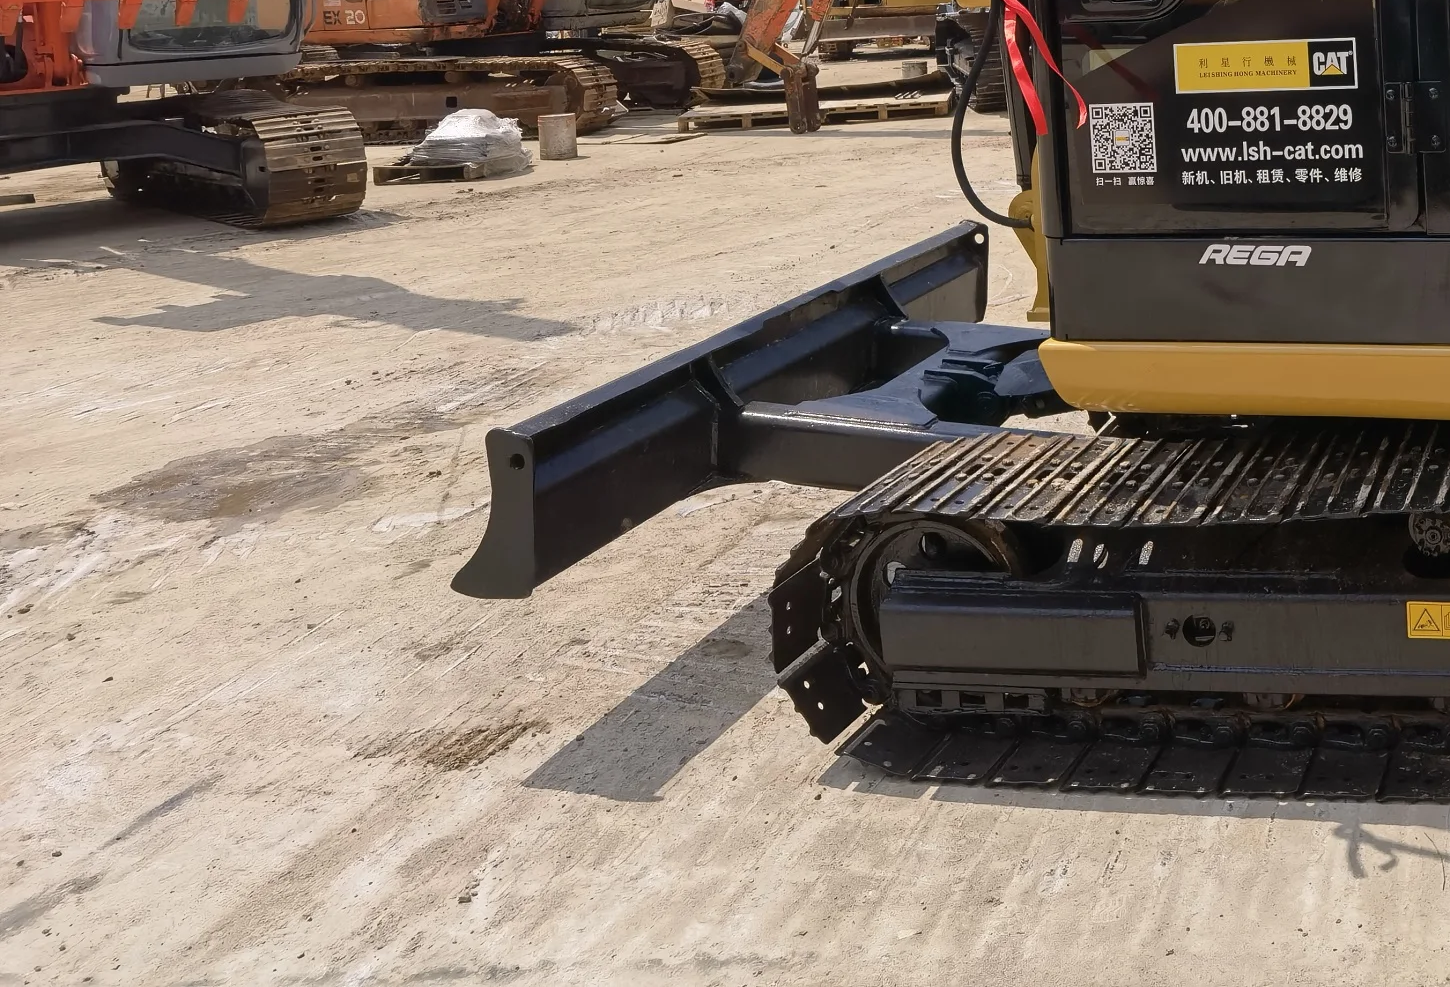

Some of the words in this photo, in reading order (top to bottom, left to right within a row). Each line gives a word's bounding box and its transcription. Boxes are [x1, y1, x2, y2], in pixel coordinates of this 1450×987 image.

[322, 10, 342, 26] EX
[1255, 69, 1297, 77] MACHINERY
[1186, 104, 1353, 134] 400-881-8829
[1181, 140, 1364, 163] www.lsh-cat.com
[1095, 176, 1122, 186] 扫一扫
[1181, 168, 1363, 185] 新机、旧机、租赁、零件、维修
[1198, 244, 1312, 266] REGA
